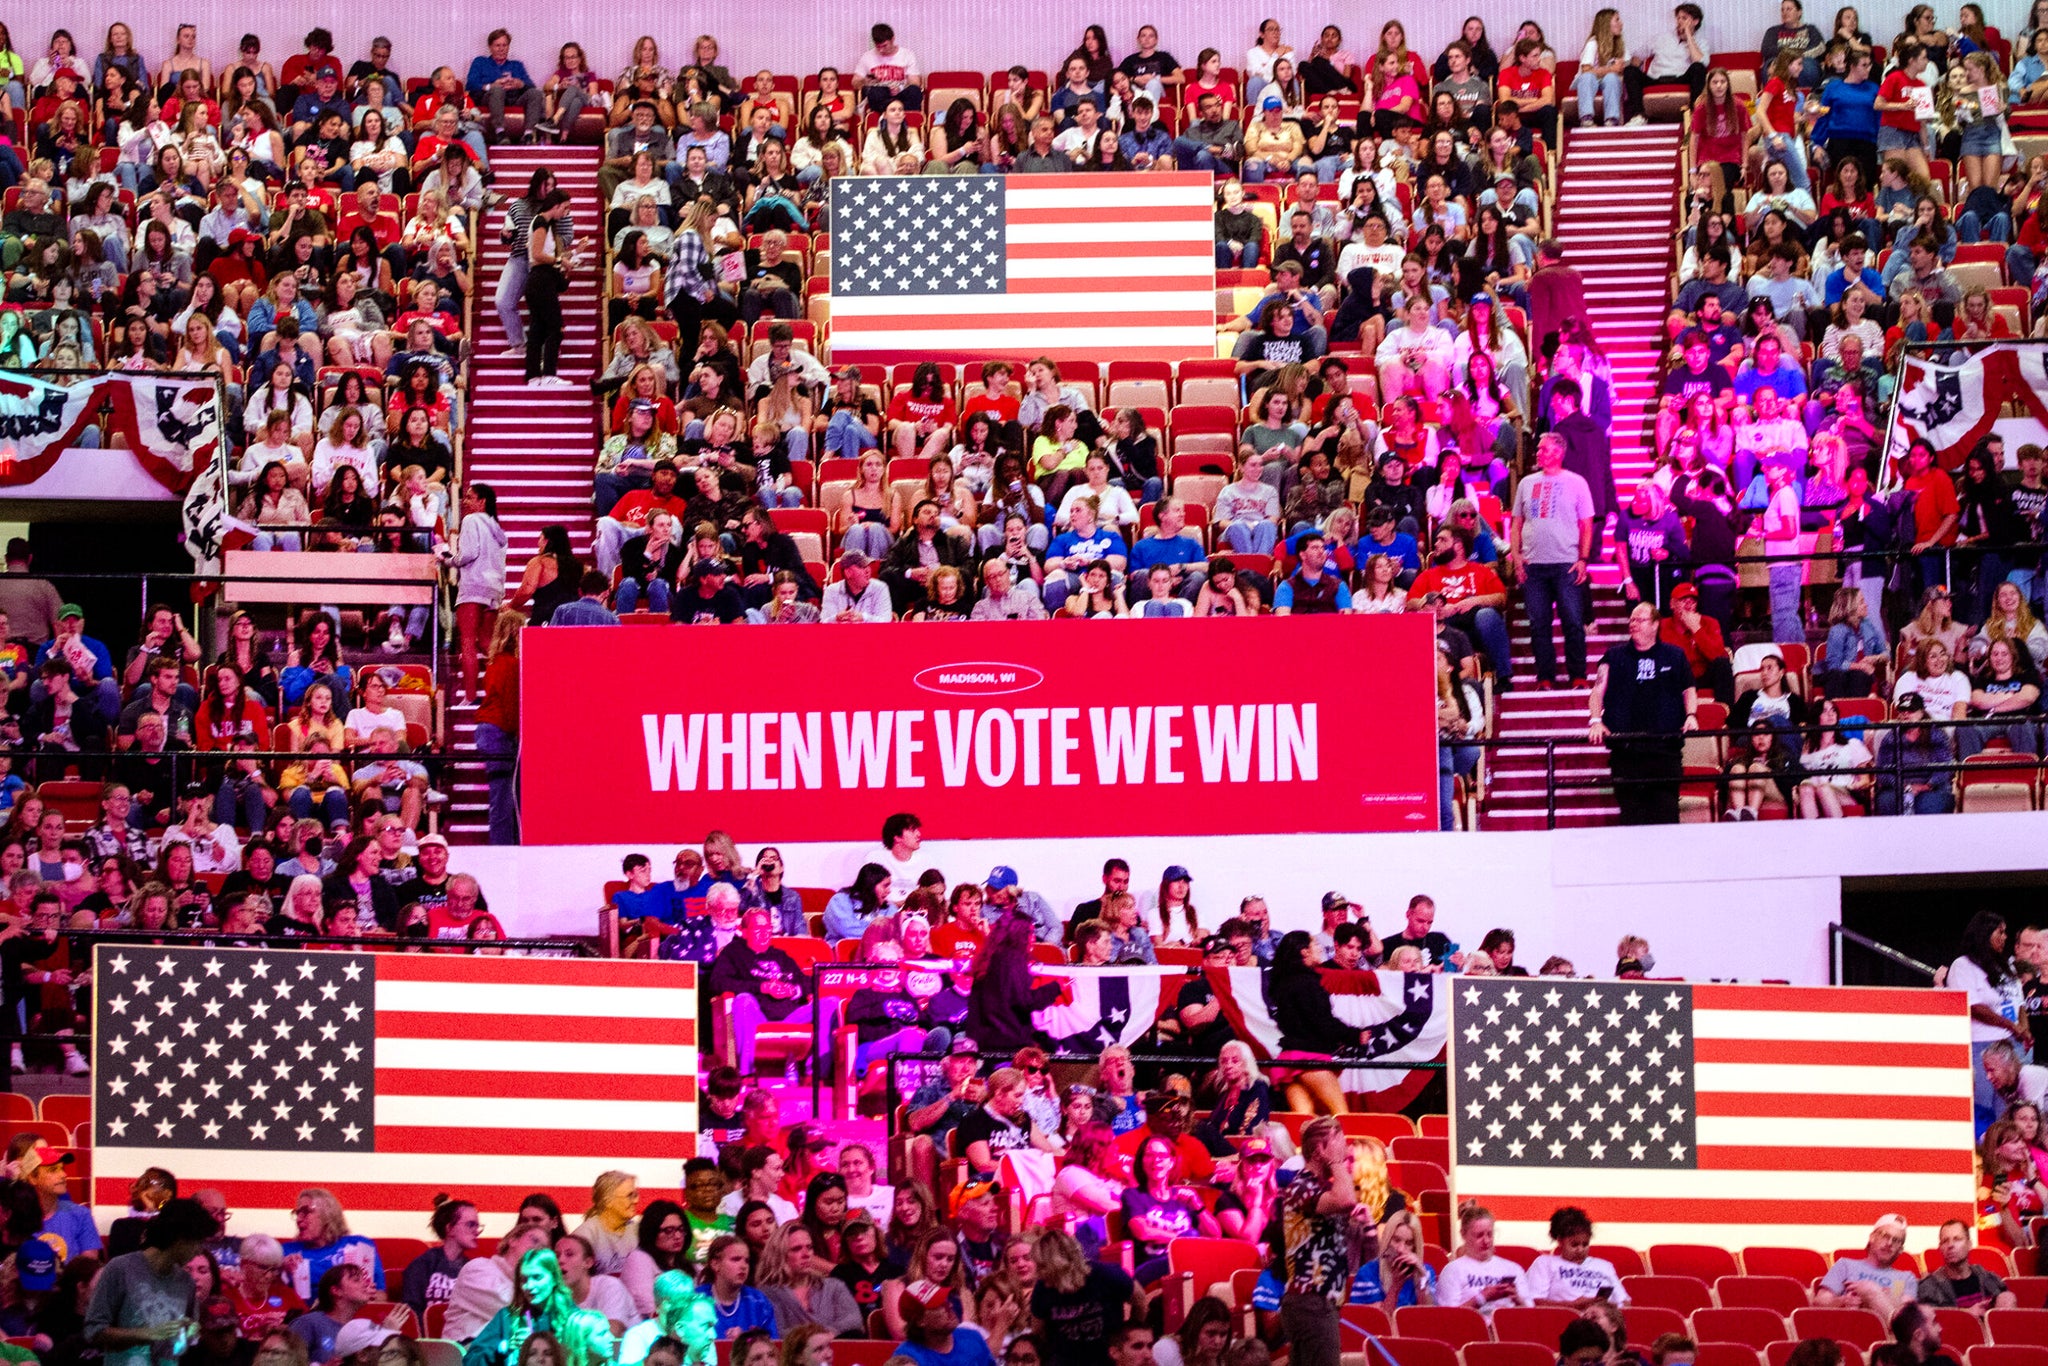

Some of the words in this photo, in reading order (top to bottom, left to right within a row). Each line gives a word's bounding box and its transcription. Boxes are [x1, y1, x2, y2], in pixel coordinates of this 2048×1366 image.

[939, 673, 999, 685] MADISON,
[1000, 672, 1016, 683] WI
[642, 712, 822, 791] WHEN
[830, 710, 925, 789] WE
[934, 707, 1081, 788] VOTE
[1088, 705, 1185, 785] WE
[1192, 703, 1318, 783] WIN
[823, 973, 844, 985] 227
